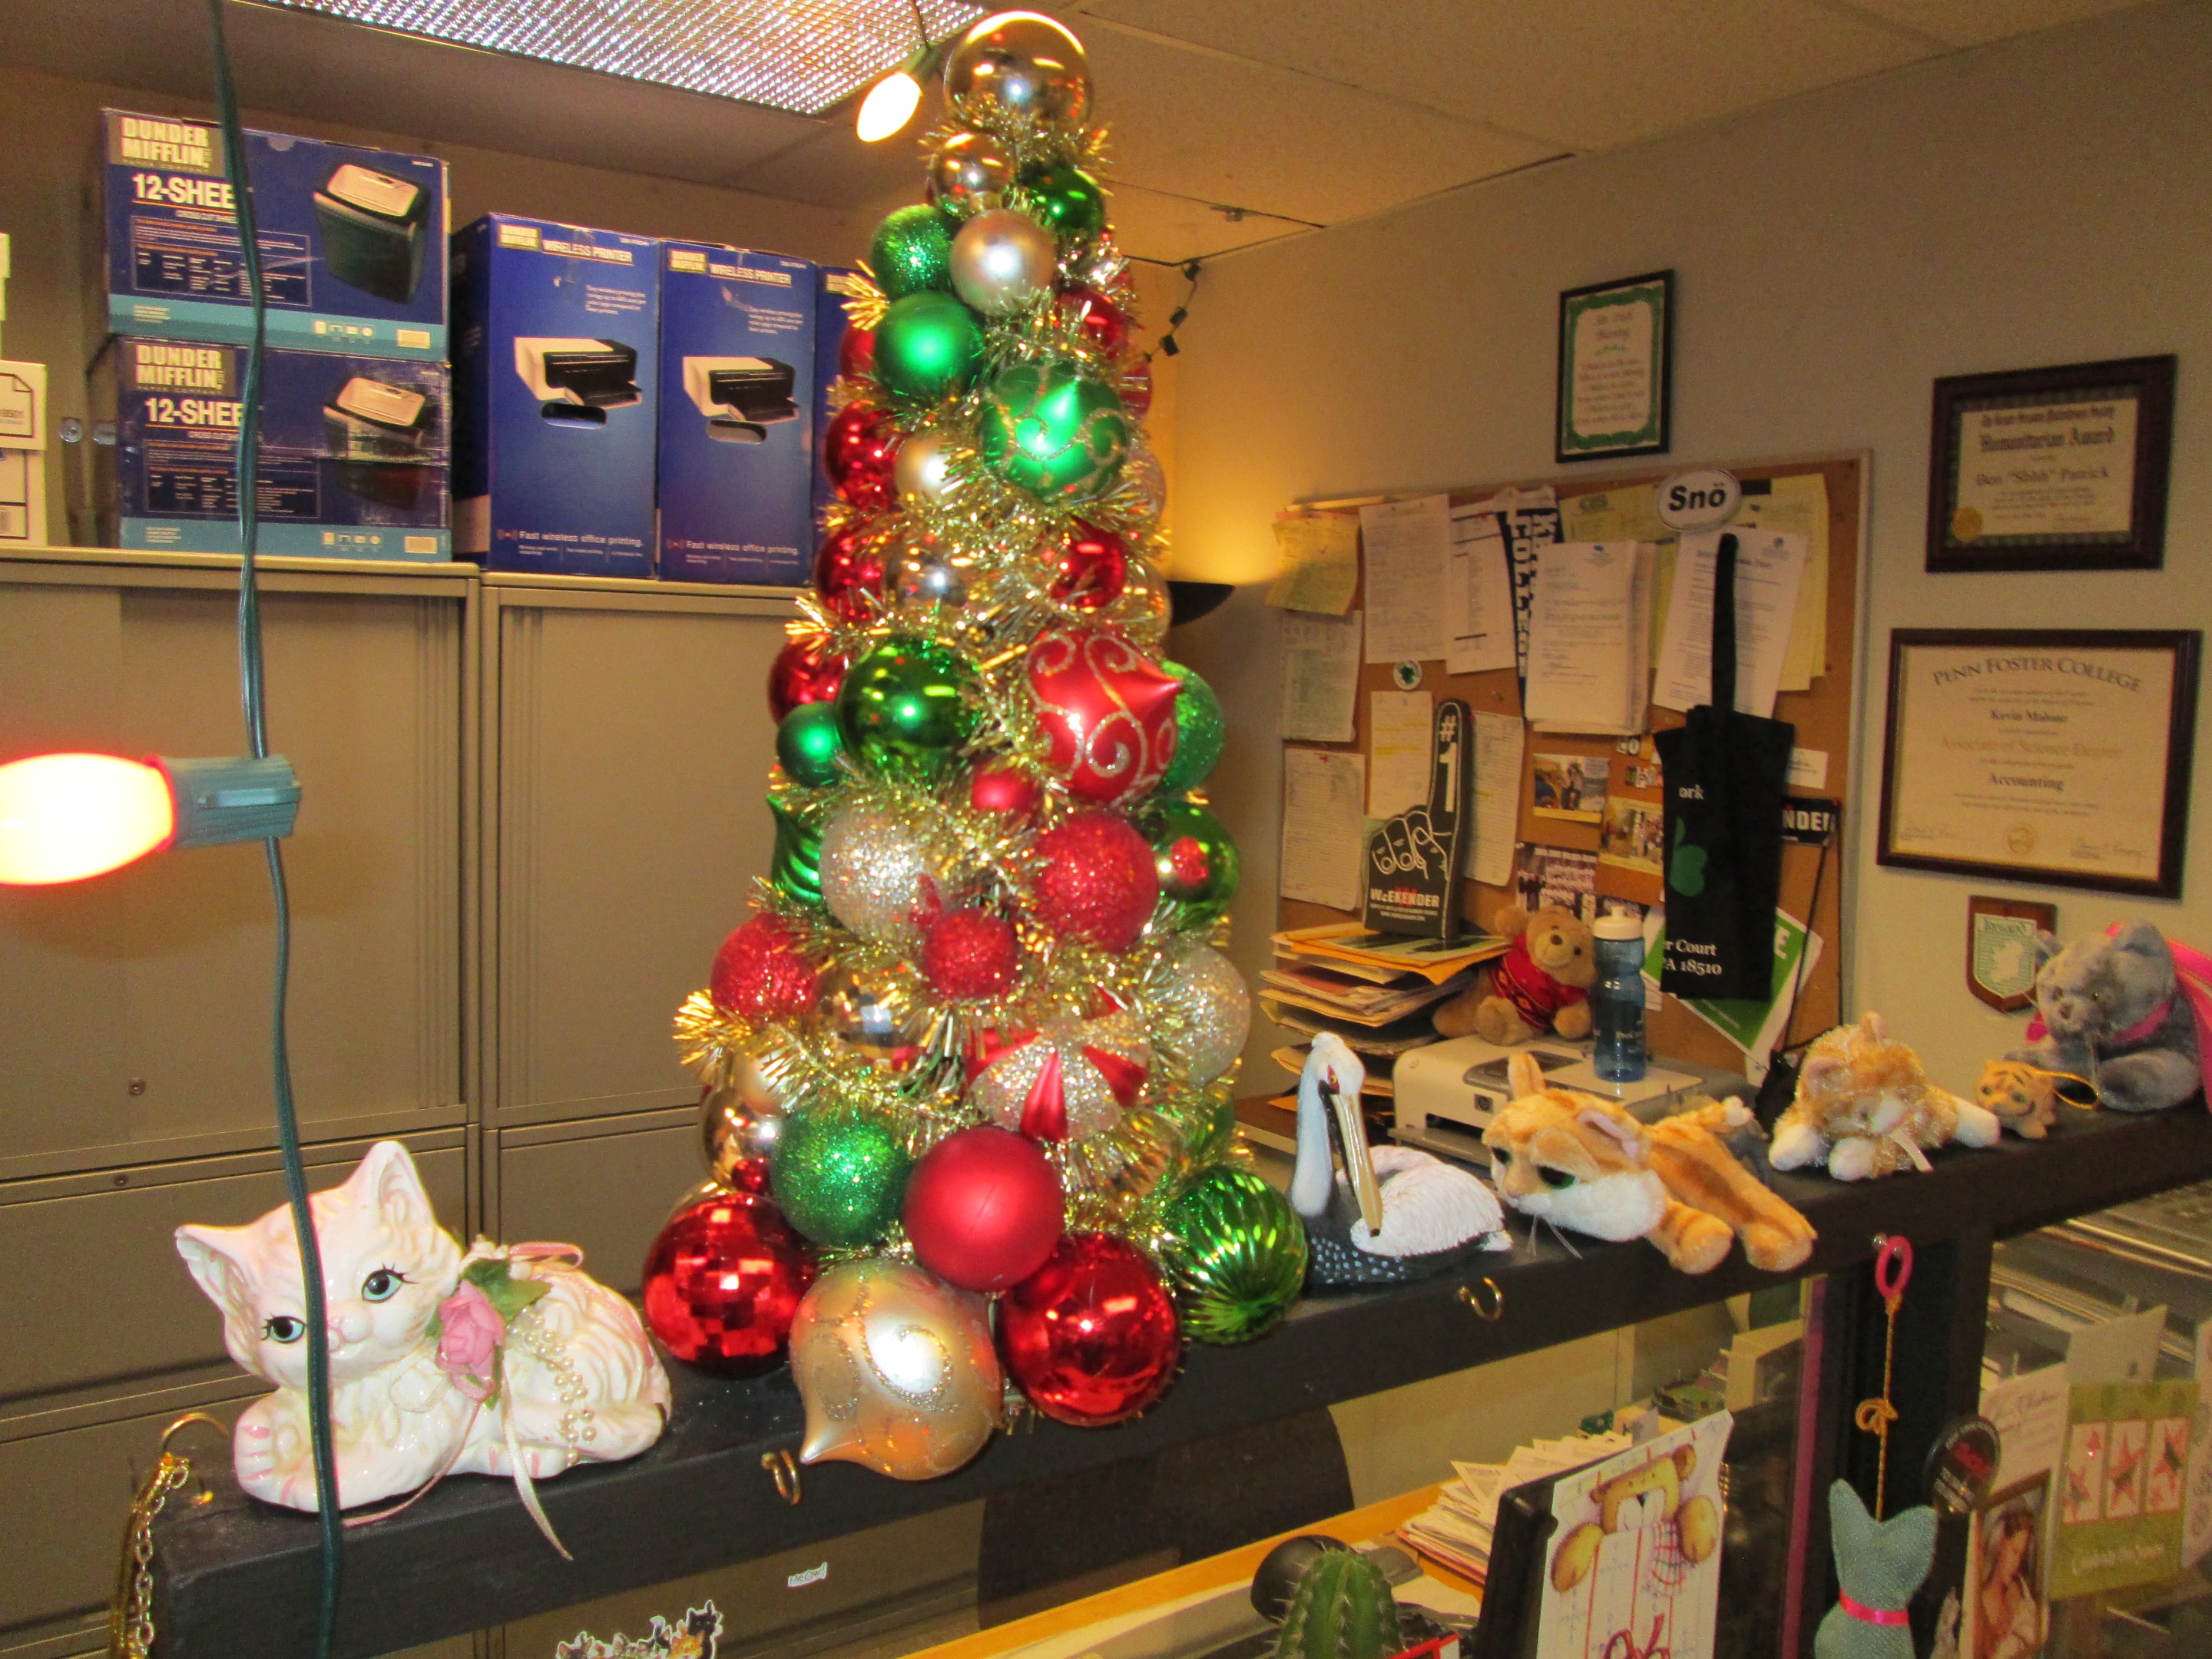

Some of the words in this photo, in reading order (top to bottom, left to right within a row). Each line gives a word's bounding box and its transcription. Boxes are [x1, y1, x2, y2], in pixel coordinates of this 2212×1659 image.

[121, 117, 210, 147] DUNDER
[132, 173, 253, 210] 12-SHEE
[542, 240, 591, 256] WIRELESS
[592, 246, 632, 263] PRINTER
[710, 263, 754, 278] WIRELESS
[755, 270, 792, 284] PRINTER
[136, 345, 221, 369] DUNDER
[144, 398, 265, 427] 12-SHEE
[519, 531, 539, 540] Fast
[541, 533, 578, 542] wireless
[580, 534, 606, 544] office
[686, 540, 705, 549] Fast
[707, 542, 740, 551] wireless
[742, 544, 766, 552] office
[1932, 662, 1982, 686] PENN
[1985, 657, 2054, 674] FOSTER
[2056, 657, 2144, 692] COLLEGE
[1991, 710, 2023, 721] Kevin
[1989, 773, 2064, 792] Accounting
[1675, 939, 1717, 957] Court
[1680, 959, 1723, 976] 18510
